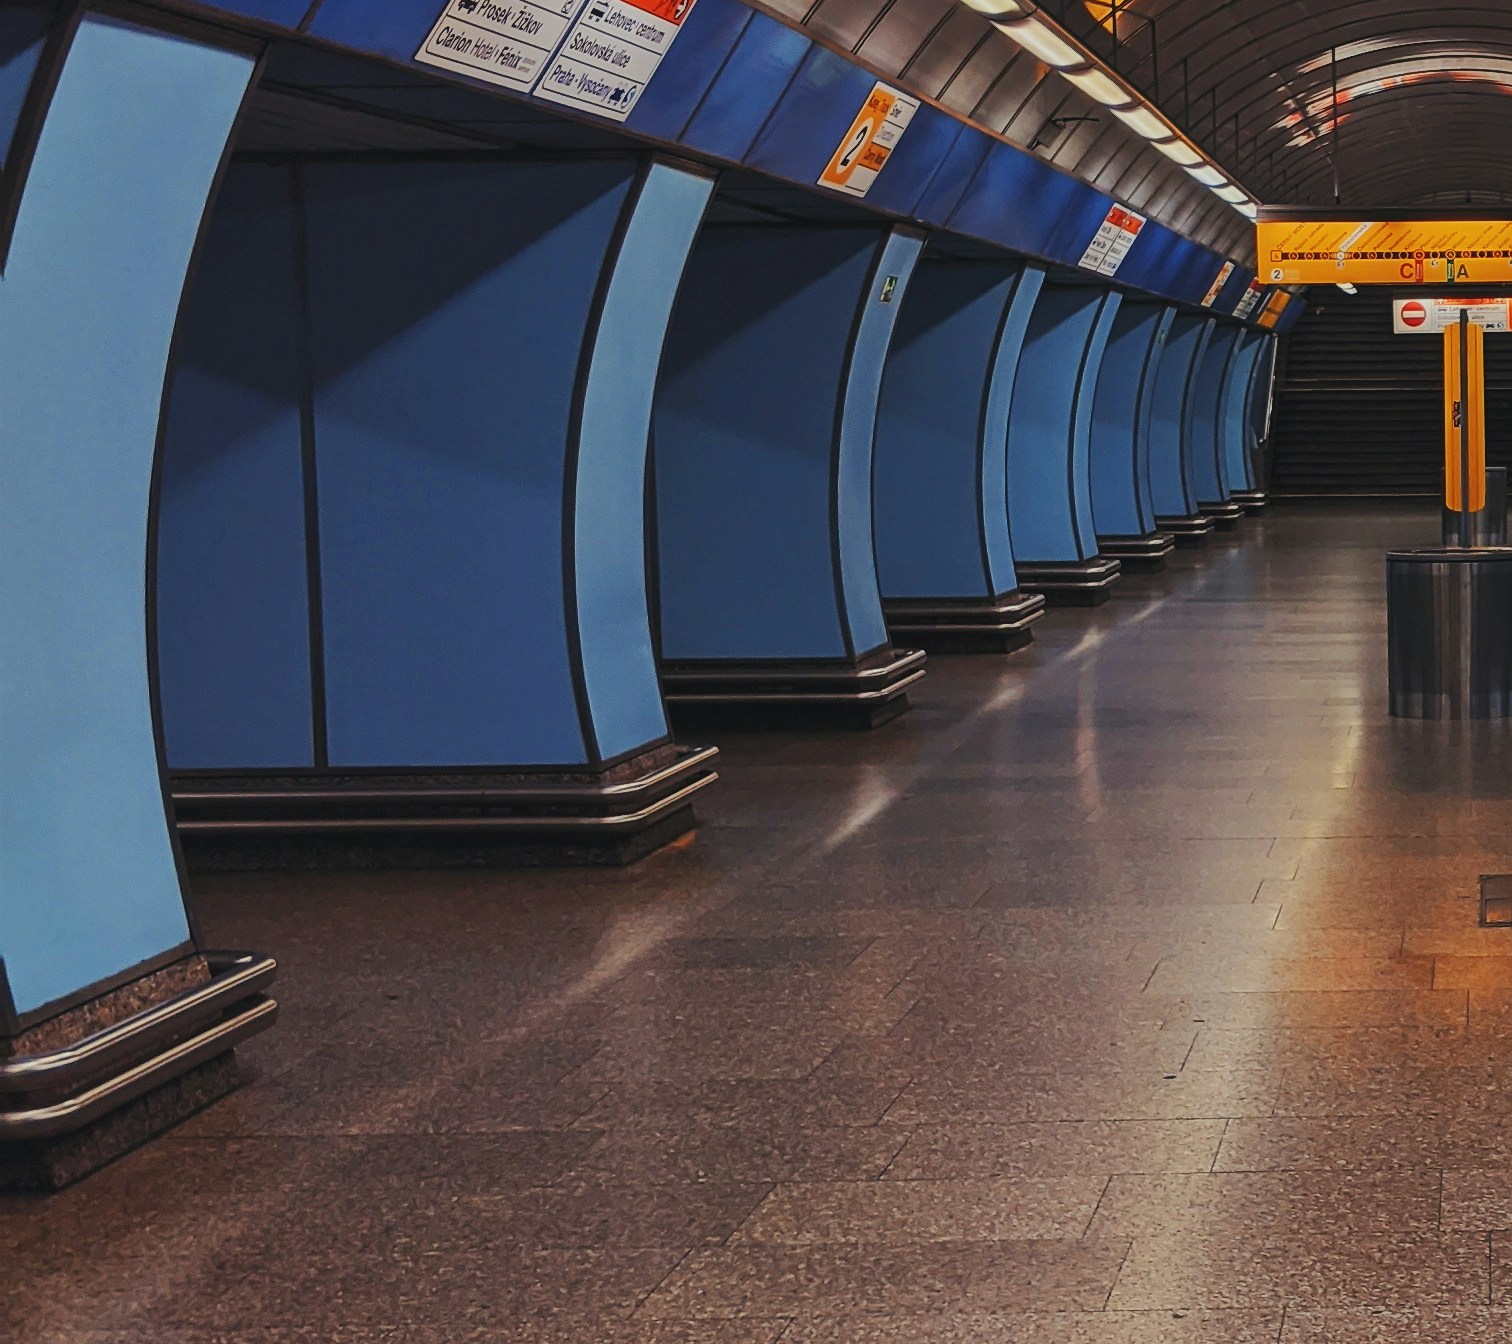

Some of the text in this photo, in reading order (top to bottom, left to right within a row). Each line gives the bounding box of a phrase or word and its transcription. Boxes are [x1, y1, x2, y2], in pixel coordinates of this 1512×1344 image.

[511, 5, 544, 36] Žižkov
[604, 6, 666, 45] Lehovec centrum
[435, 25, 523, 70] Clarion Hotel Fénix
[570, 31, 631, 69] Sokolovská ulice
[550, 64, 575, 87] Praha
[840, 125, 869, 167] 2
[1273, 269, 1282, 280] 2
[1400, 262, 1415, 280] C
[1456, 263, 1470, 279] A
